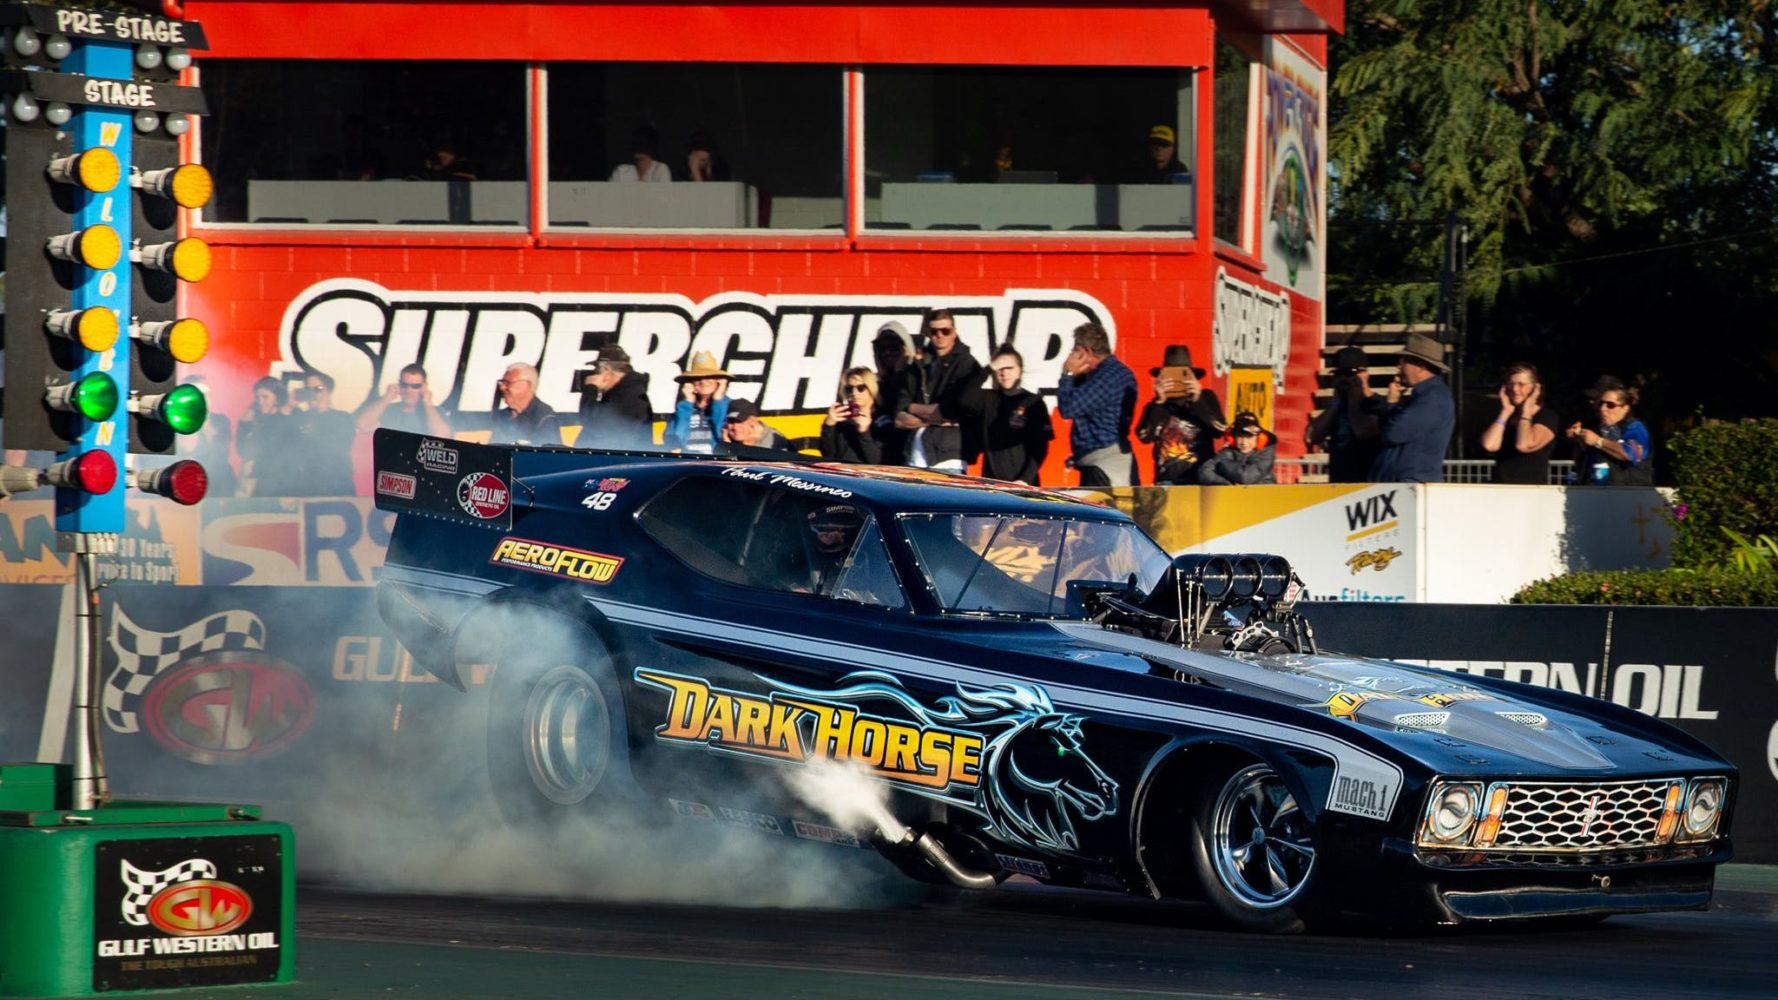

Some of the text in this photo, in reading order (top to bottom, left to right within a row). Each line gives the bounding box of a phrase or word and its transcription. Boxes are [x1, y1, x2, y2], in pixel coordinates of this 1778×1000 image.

[56, 9, 185, 43] PRE-STAGE
[84, 79, 156, 107] STAGE
[426, 448, 457, 464] WELD
[379, 474, 413, 495] SIMPSON
[471, 486, 506, 504] RED LINE
[581, 491, 617, 510] 48
[1345, 489, 1398, 531] WIX
[493, 540, 619, 582] AEROFLOW
[332, 635, 440, 683] GUL
[1612, 663, 1719, 720] OIL
[634, 666, 984, 789] DARK HORSE
[1335, 803, 1385, 818] MUSTANG
[1378, 784, 1389, 812] 1
[98, 932, 280, 957] GULF WESTERN OIL
